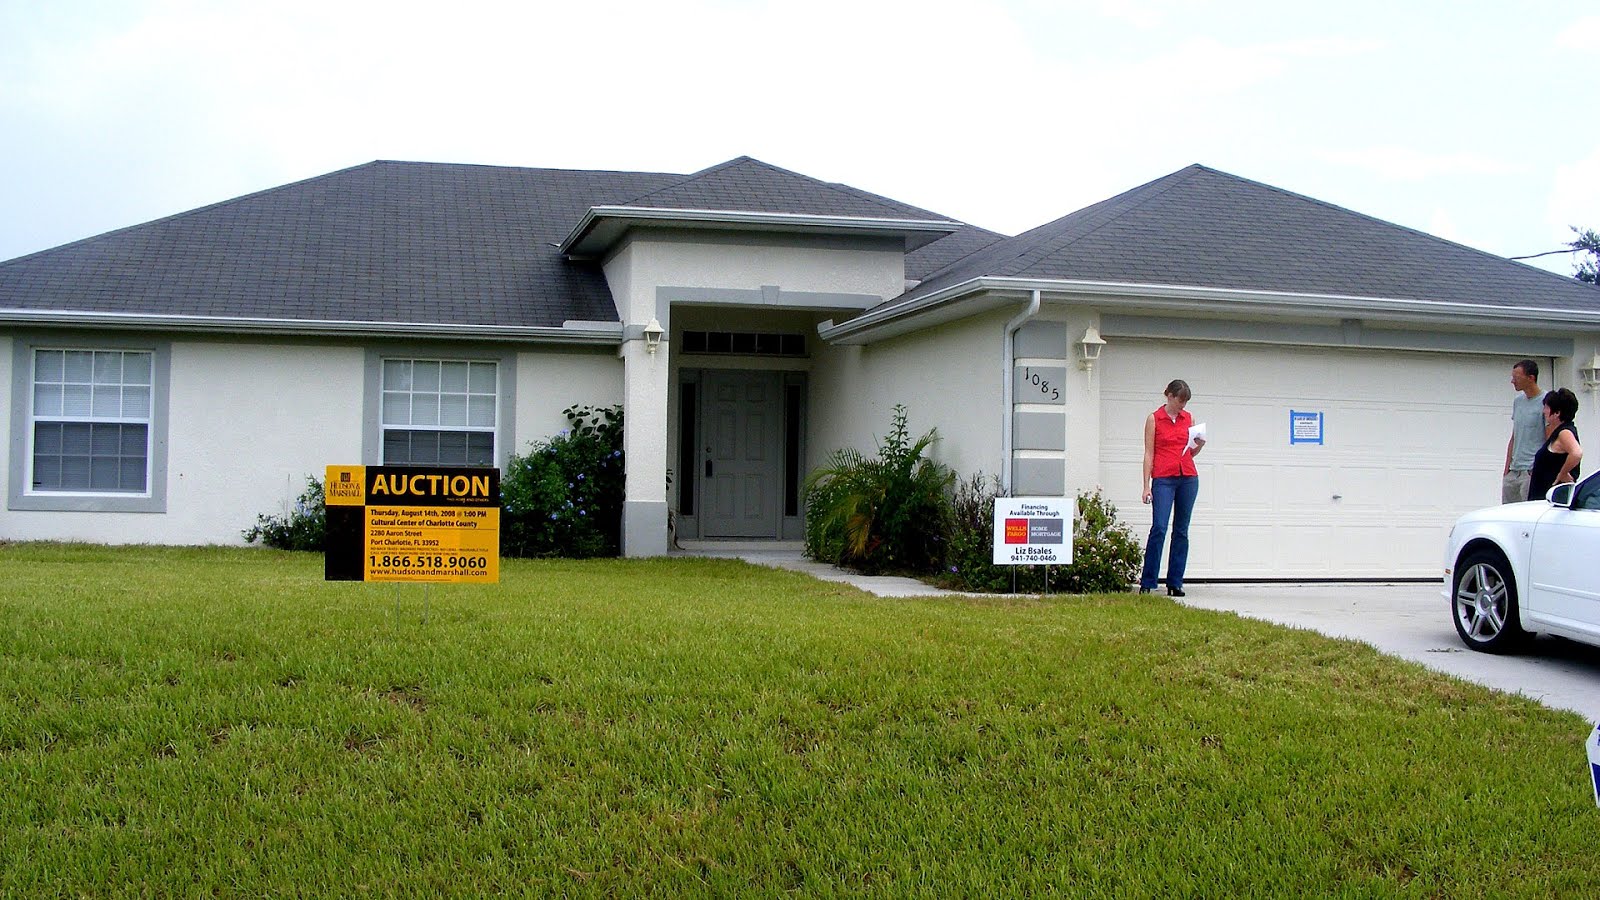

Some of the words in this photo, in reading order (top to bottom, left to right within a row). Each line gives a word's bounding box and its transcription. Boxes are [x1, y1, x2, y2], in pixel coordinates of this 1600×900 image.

[1025, 366, 1059, 401] 1085
[371, 474, 490, 497] AUCTION
[329, 489, 362, 497] MARSHALL
[1021, 503, 1049, 511] Financing
[370, 509, 401, 518] Thursday,
[401, 509, 423, 518] August
[440, 510, 456, 518] 2008
[463, 510, 477, 518] 1:00
[370, 518, 396, 526] Cultural
[396, 518, 417, 526] Center
[425, 519, 455, 527] Charlotte
[455, 520, 478, 529] County
[370, 529, 385, 537] 2280
[370, 538, 383, 546] Port
[384, 539, 413, 547] Charlotte,
[421, 539, 440, 547] 33952
[1015, 547, 1027, 555] Liz
[1027, 546, 1053, 555] Bsales
[369, 555, 487, 569] 1.866.518.9060
[1010, 554, 1057, 562] 941-740-0460
[370, 568, 488, 576] www.hudsonandmarshall.com
